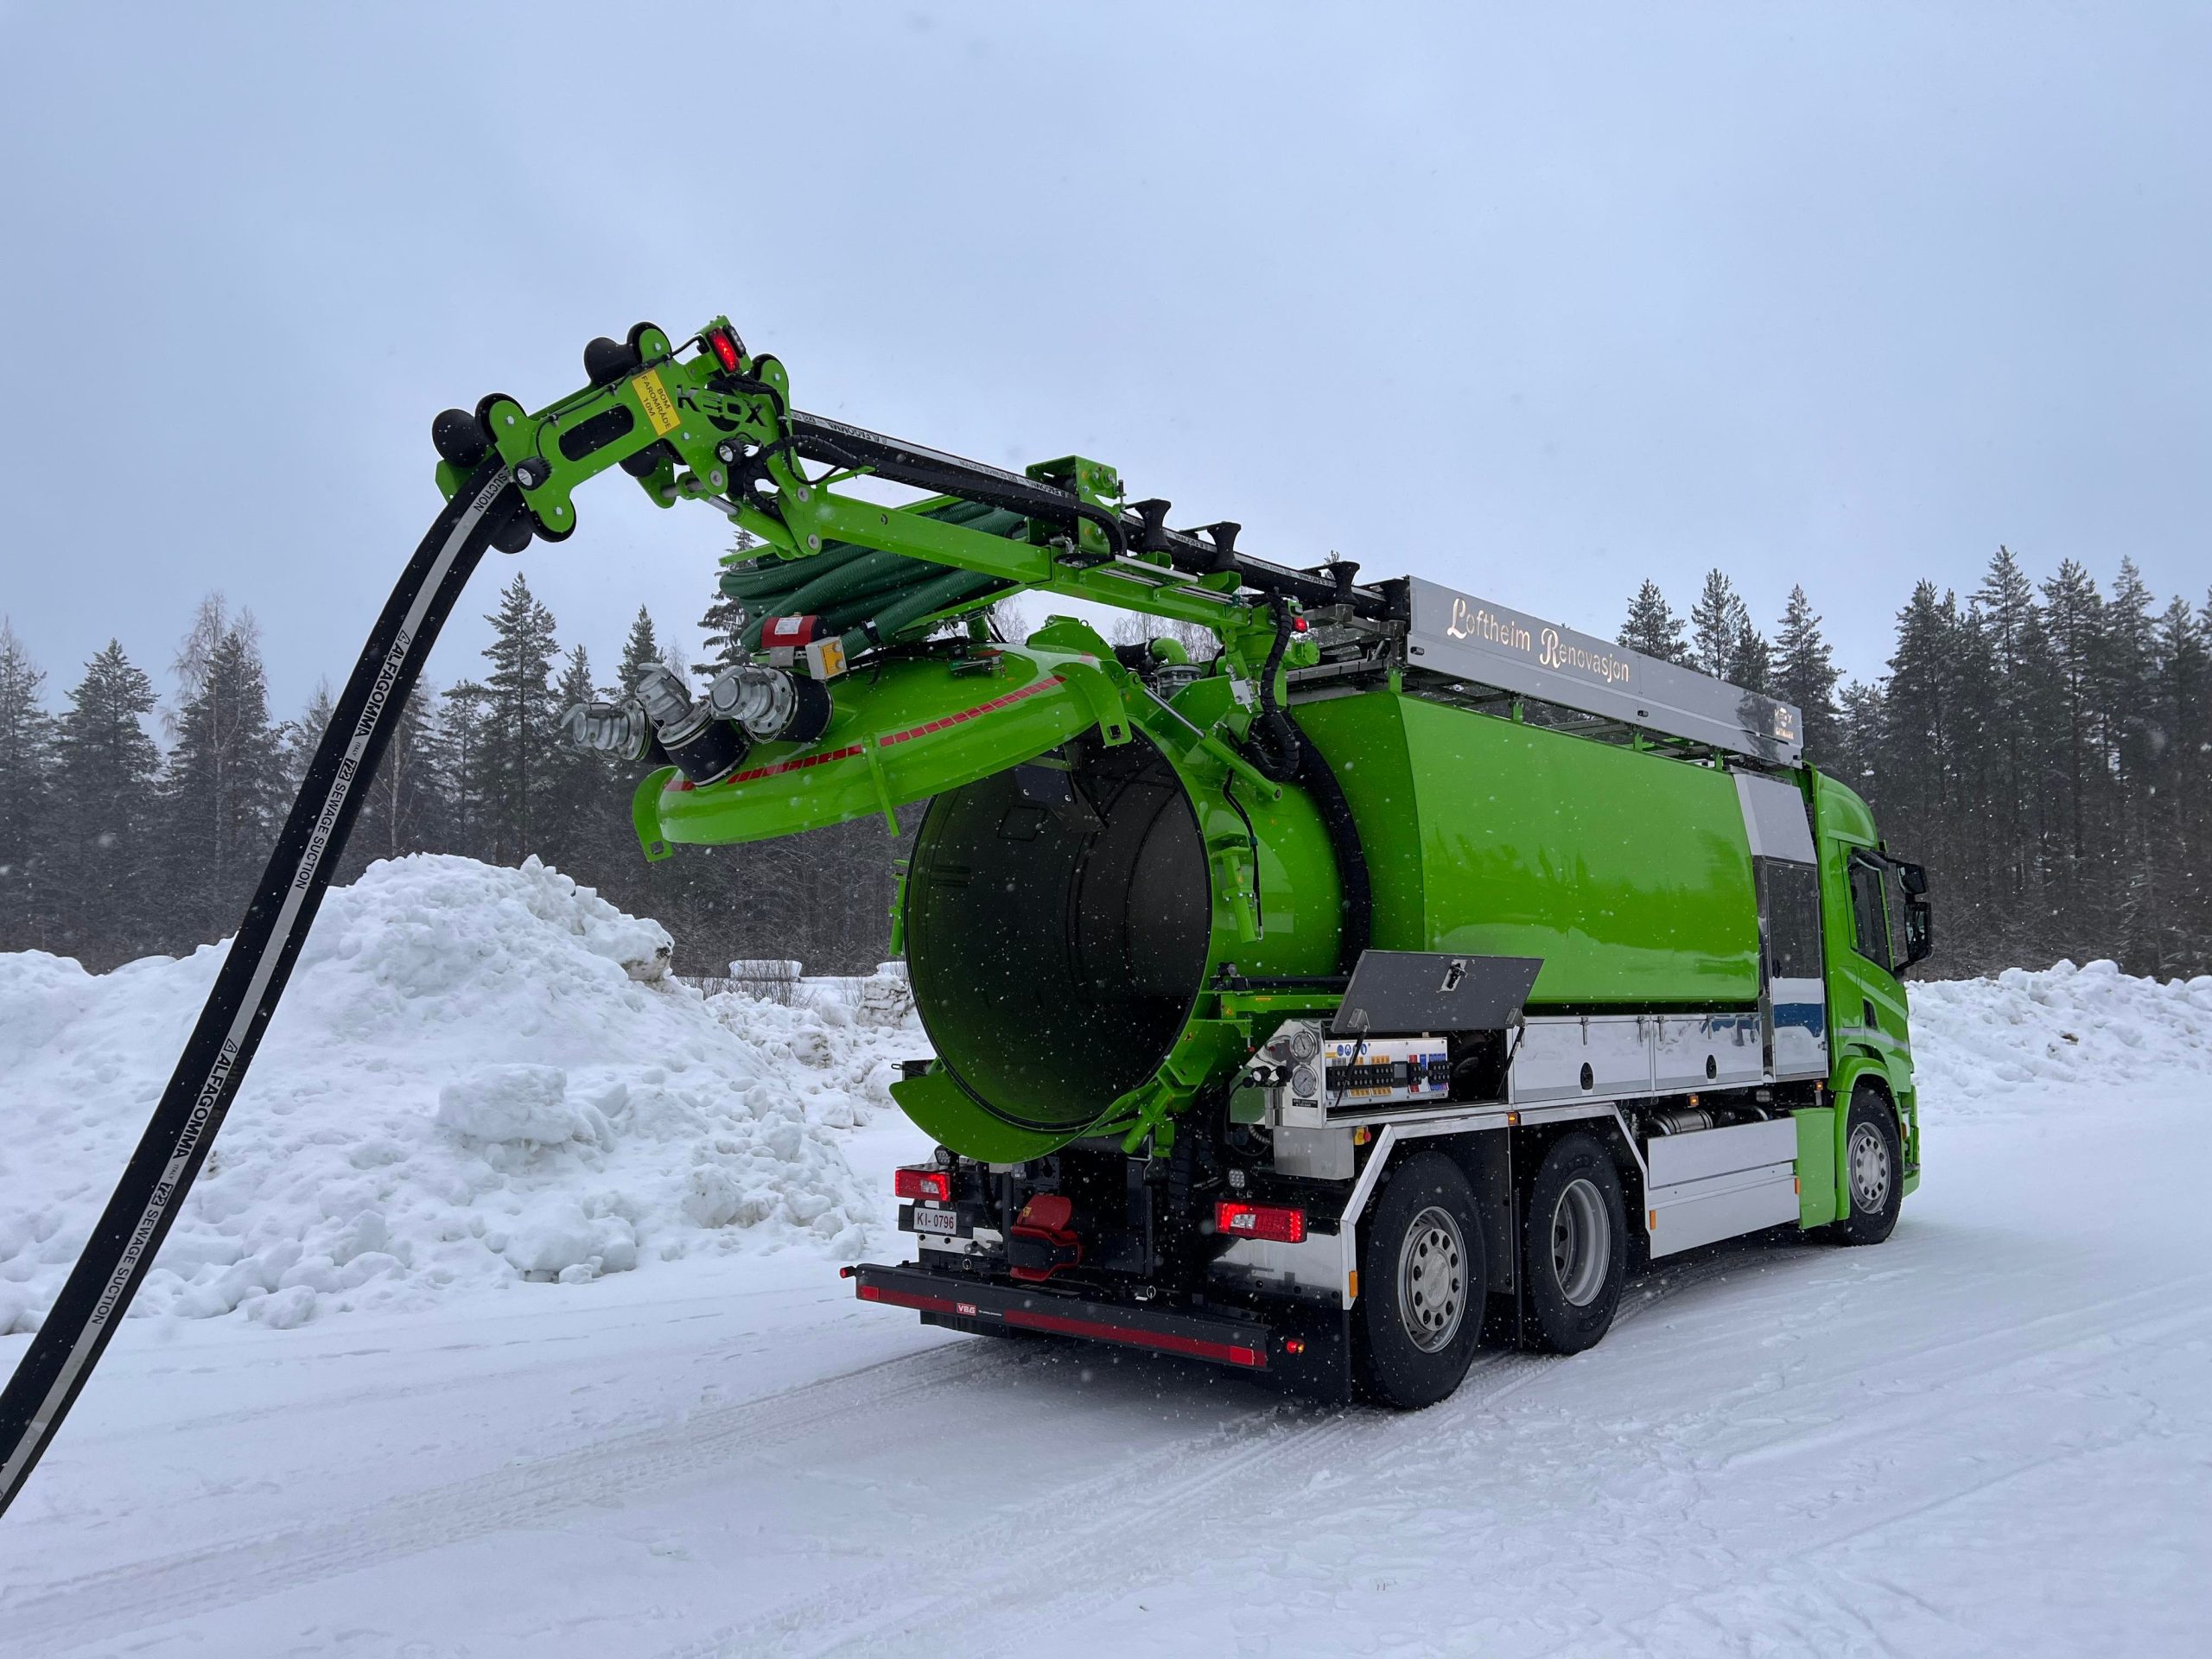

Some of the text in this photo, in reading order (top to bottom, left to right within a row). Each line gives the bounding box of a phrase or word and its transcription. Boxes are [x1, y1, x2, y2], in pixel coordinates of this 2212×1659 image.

[641, 375, 672, 429] FAROMRÅDE
[643, 397, 656, 417] 10M
[657, 387, 671, 409] BOM
[473, 473, 508, 512] SUCTION
[1446, 597, 1629, 683] Loftheim Renovasjon
[295, 645, 405, 889] ALFAGOMMA ITALY 722 SEWAGE SUCTION
[173, 1054, 232, 1159] ALFAGOMMA
[150, 1181, 171, 1207] 722
[123, 1209, 159, 1265] SEWAGE
[934, 1214, 954, 1229] 0796
[91, 1268, 130, 1325] SUCTION
[958, 1304, 976, 1314] VBG
